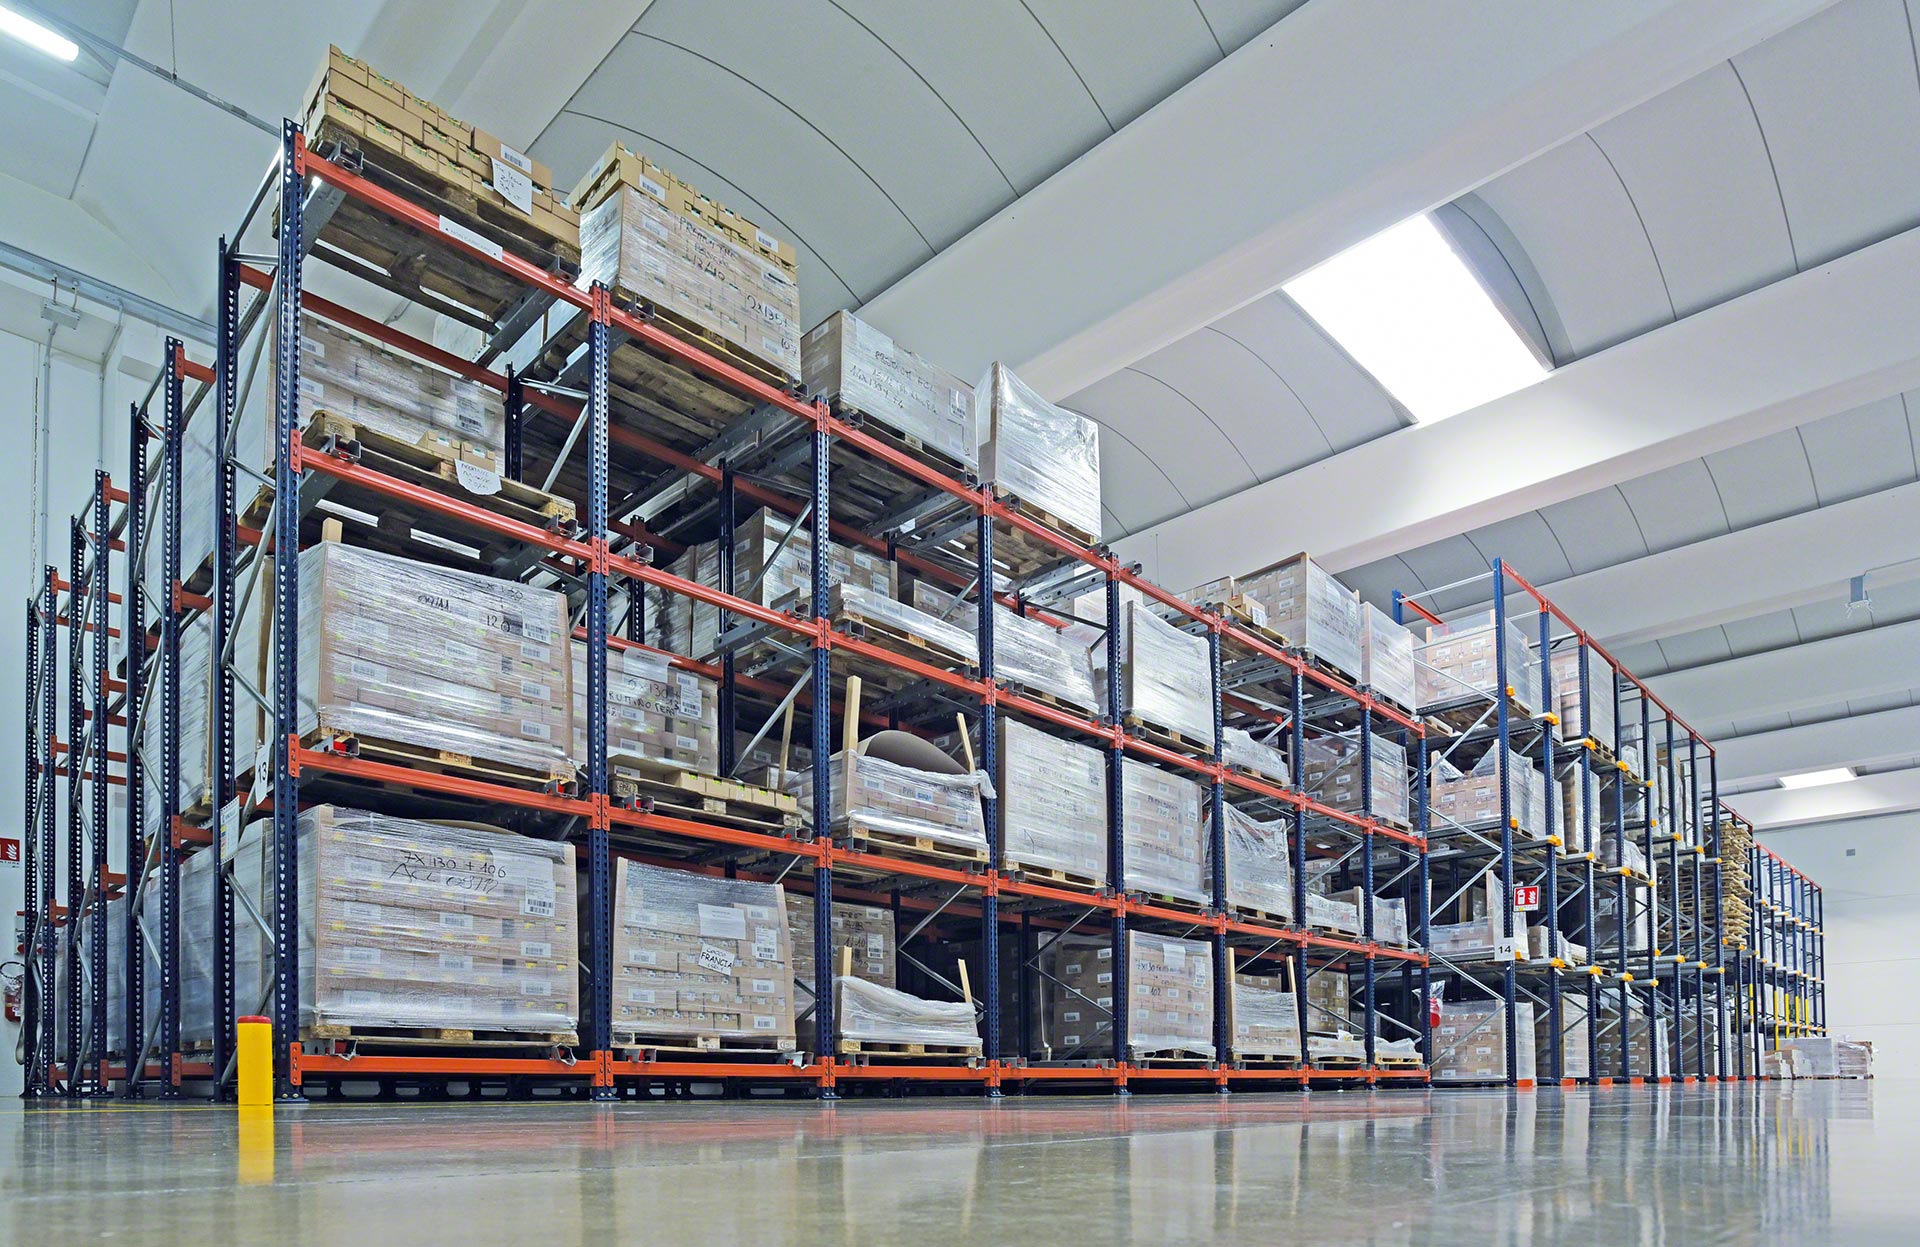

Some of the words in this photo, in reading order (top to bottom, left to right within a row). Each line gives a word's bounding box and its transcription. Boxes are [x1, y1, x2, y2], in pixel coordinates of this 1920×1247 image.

[258, 761, 267, 780] 13
[480, 861, 507, 879] 106
[1498, 945, 1511, 953] 14
[700, 951, 732, 968] FRANCIA
